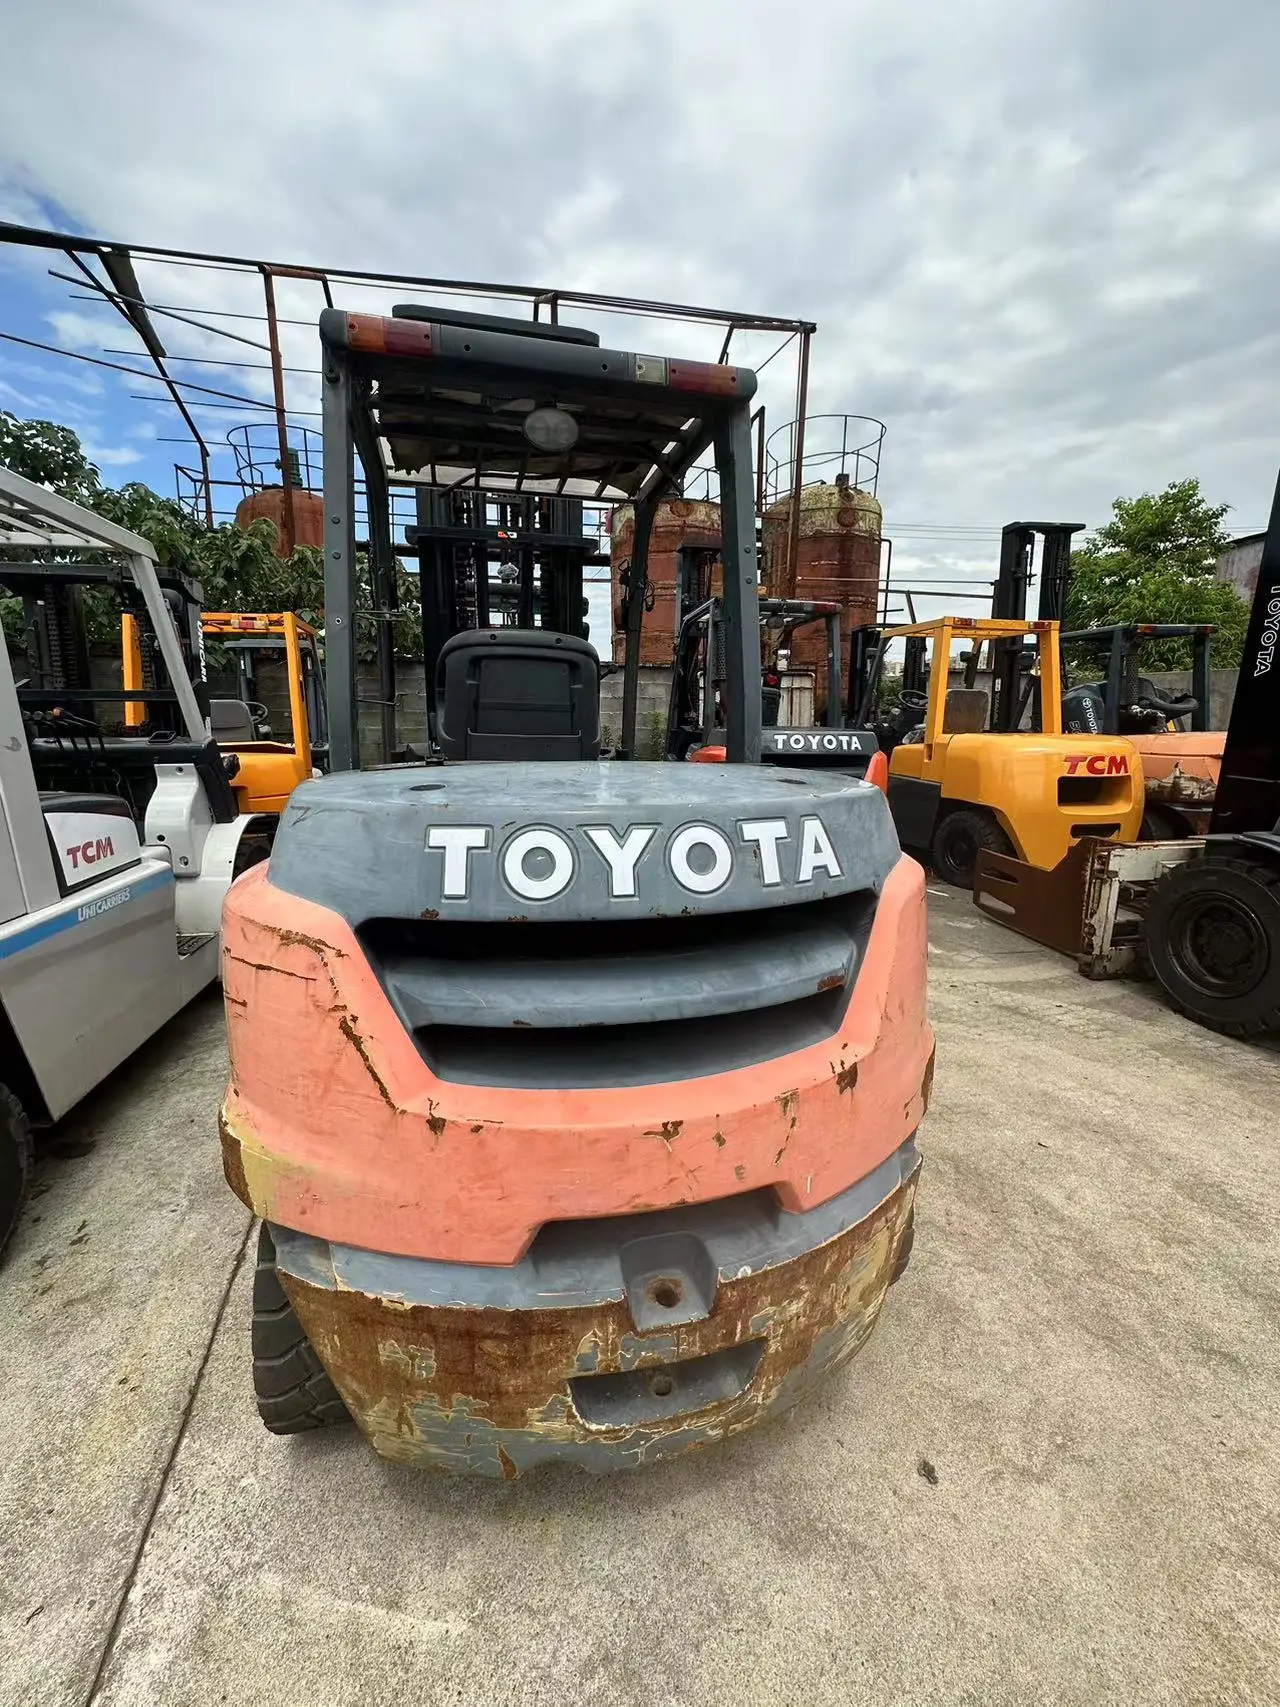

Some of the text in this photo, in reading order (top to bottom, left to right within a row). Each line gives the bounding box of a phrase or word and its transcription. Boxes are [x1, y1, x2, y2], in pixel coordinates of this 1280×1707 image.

[773, 734, 862, 751] TOYOTA
[1063, 755, 1129, 775] TCM
[66, 836, 115, 869] TCM
[428, 816, 843, 899] TOYOTA
[77, 887, 131, 922] UNICARRIERS
